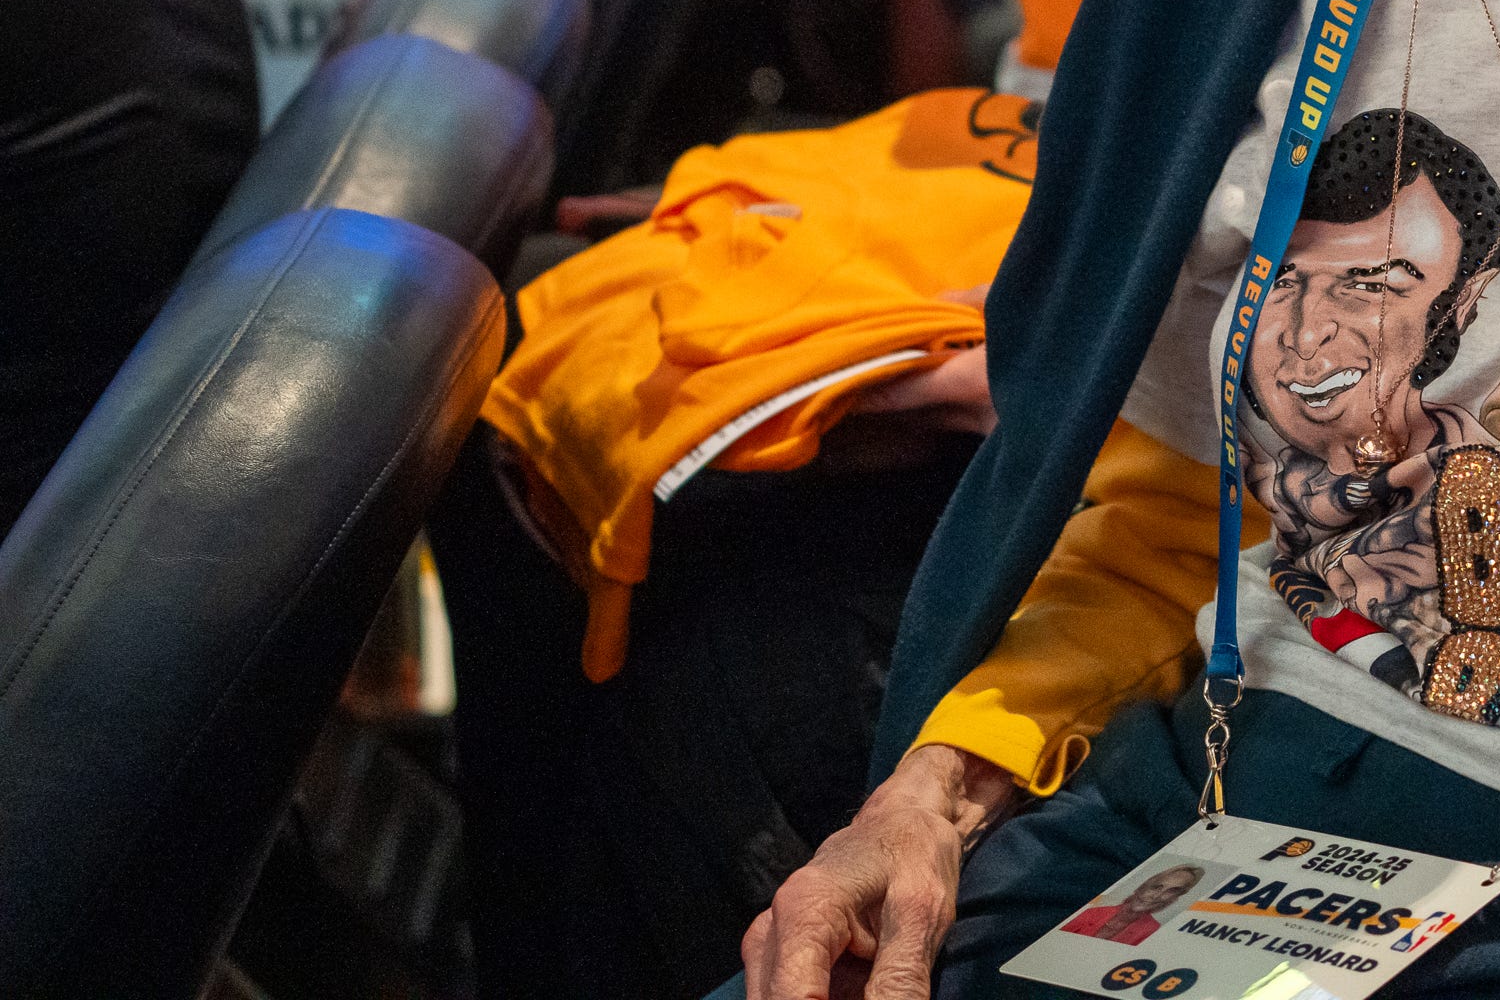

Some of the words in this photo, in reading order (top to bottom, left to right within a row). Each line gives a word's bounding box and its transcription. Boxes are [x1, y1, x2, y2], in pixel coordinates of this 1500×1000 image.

[1299, 76, 1331, 131] UP
[1224, 254, 1273, 406] REVVED
[1223, 413, 1236, 467] UP
[1301, 856, 1398, 885] SEASON
[1317, 843, 1413, 872] 2024-25
[1208, 873, 1413, 936] PACERS
[1178, 918, 1268, 947] NANCY
[1263, 937, 1379, 973] LEONARD
[1111, 966, 1148, 985] CS
[1156, 976, 1182, 992] B
